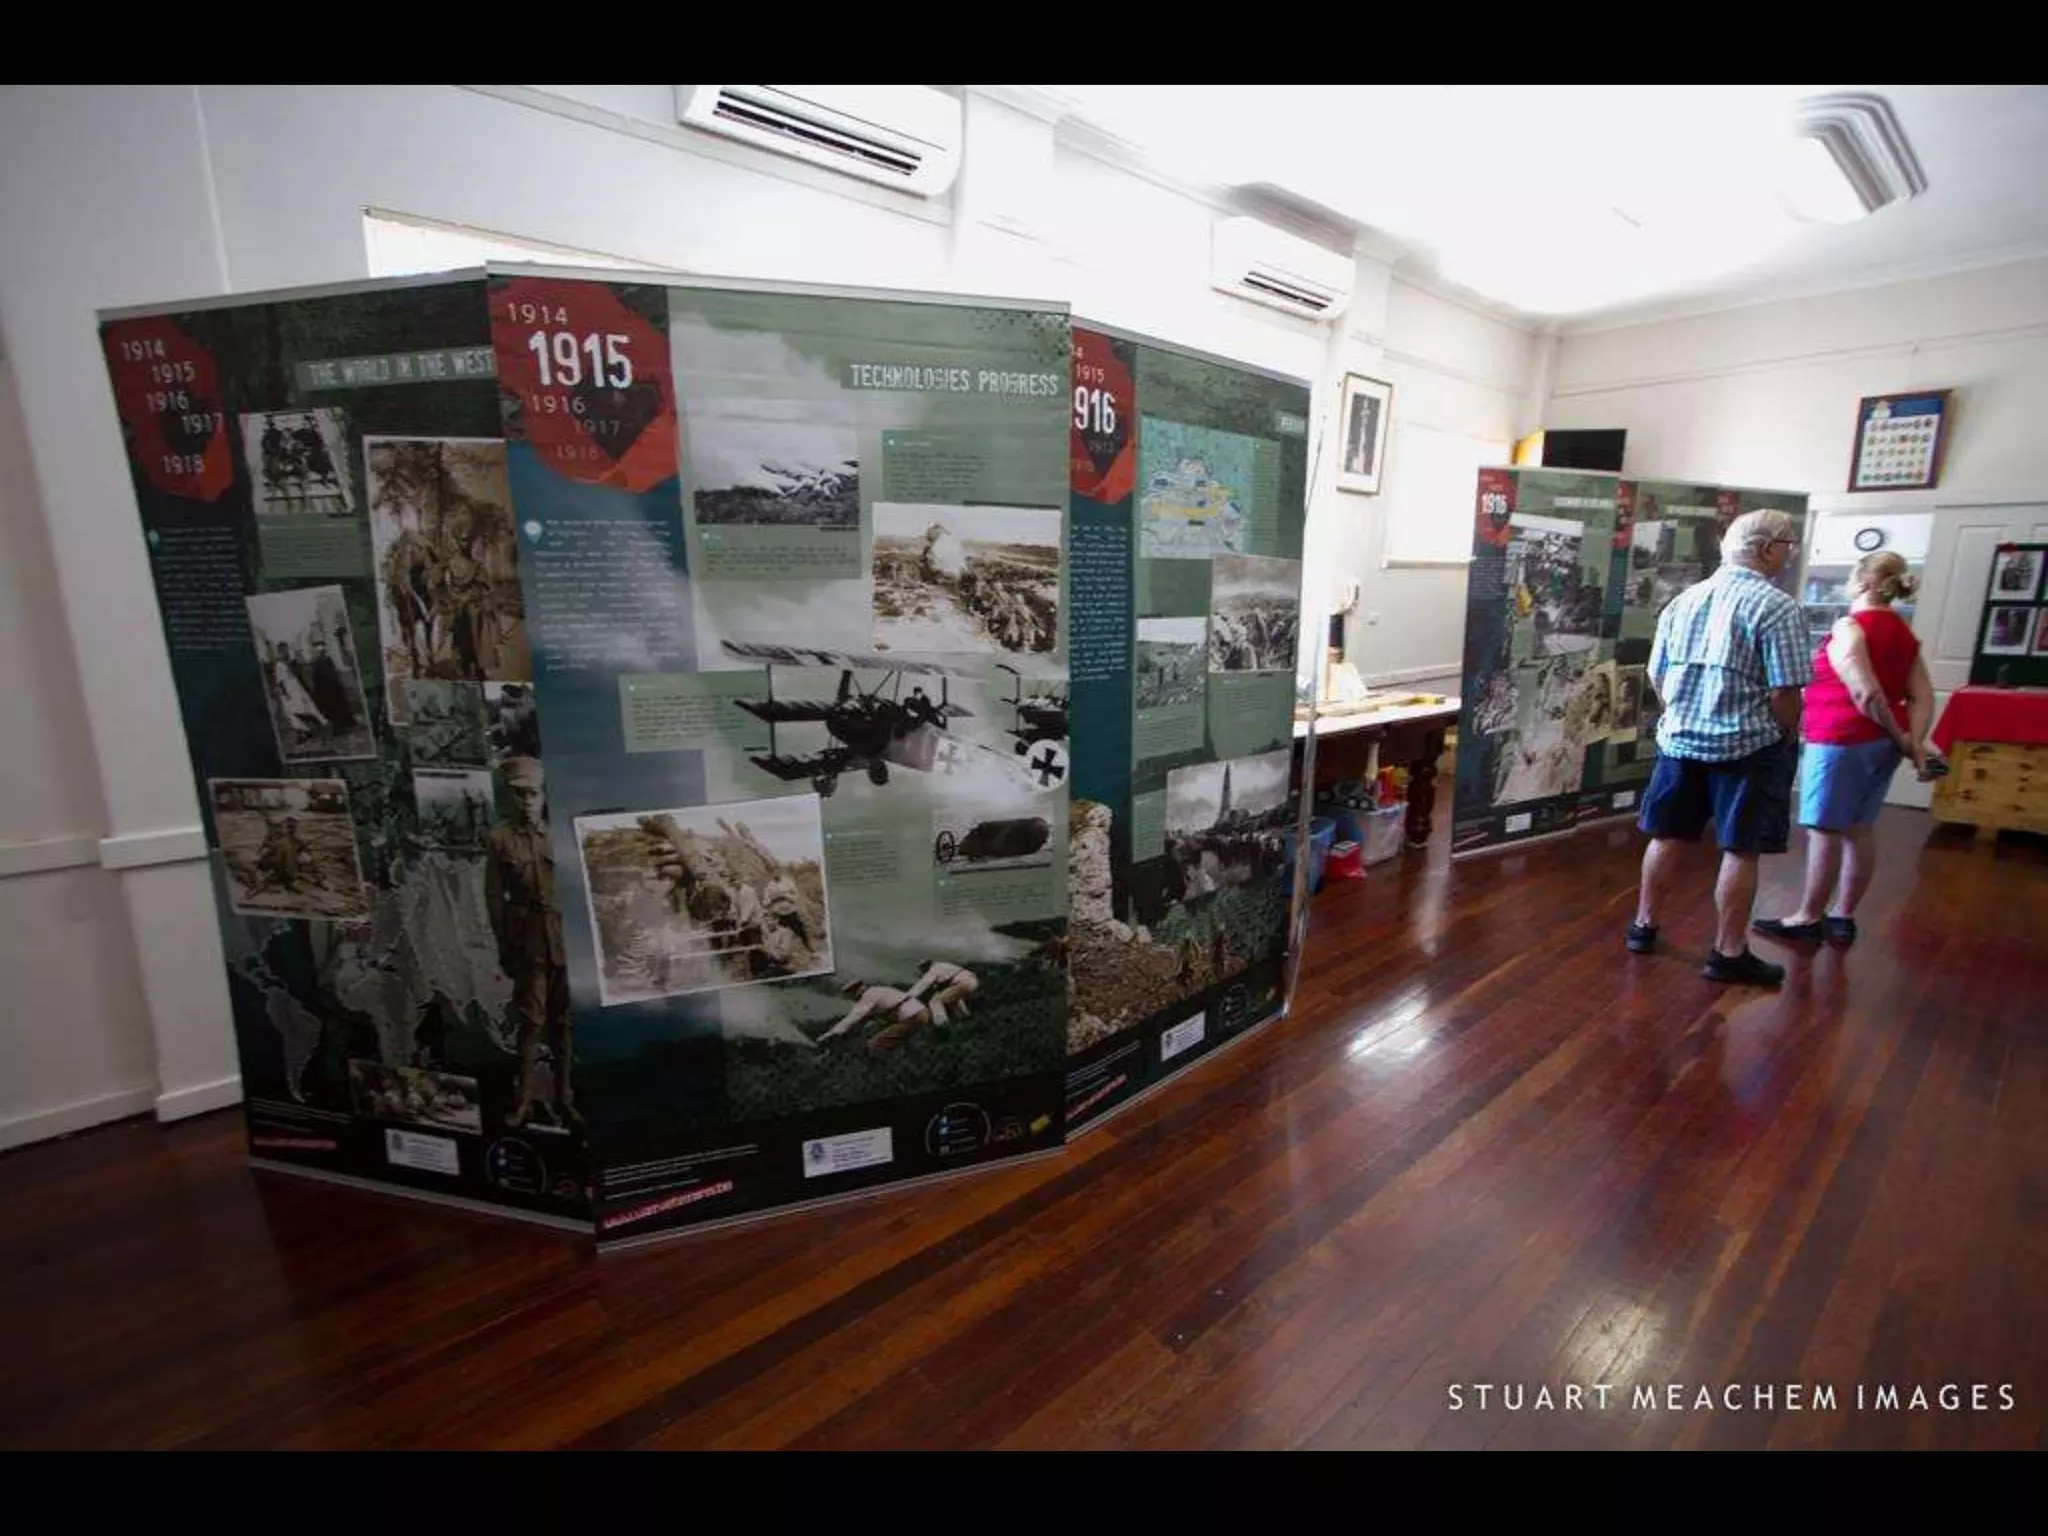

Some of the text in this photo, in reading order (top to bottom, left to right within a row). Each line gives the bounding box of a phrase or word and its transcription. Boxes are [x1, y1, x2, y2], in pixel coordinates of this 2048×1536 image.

[508, 302, 568, 326] 1914
[121, 339, 166, 361] 1914
[528, 329, 634, 389] 1915
[150, 360, 197, 384] 1915
[850, 364, 1060, 395] TECHNOLOGIES PROGRESS
[1075, 364, 1106, 384] 1915
[145, 389, 190, 413] 1916
[531, 394, 587, 414] 1916
[1074, 386, 1117, 434] 916
[574, 419, 621, 437] 1917
[163, 453, 205, 474] 1918
[556, 444, 599, 460] 1918
